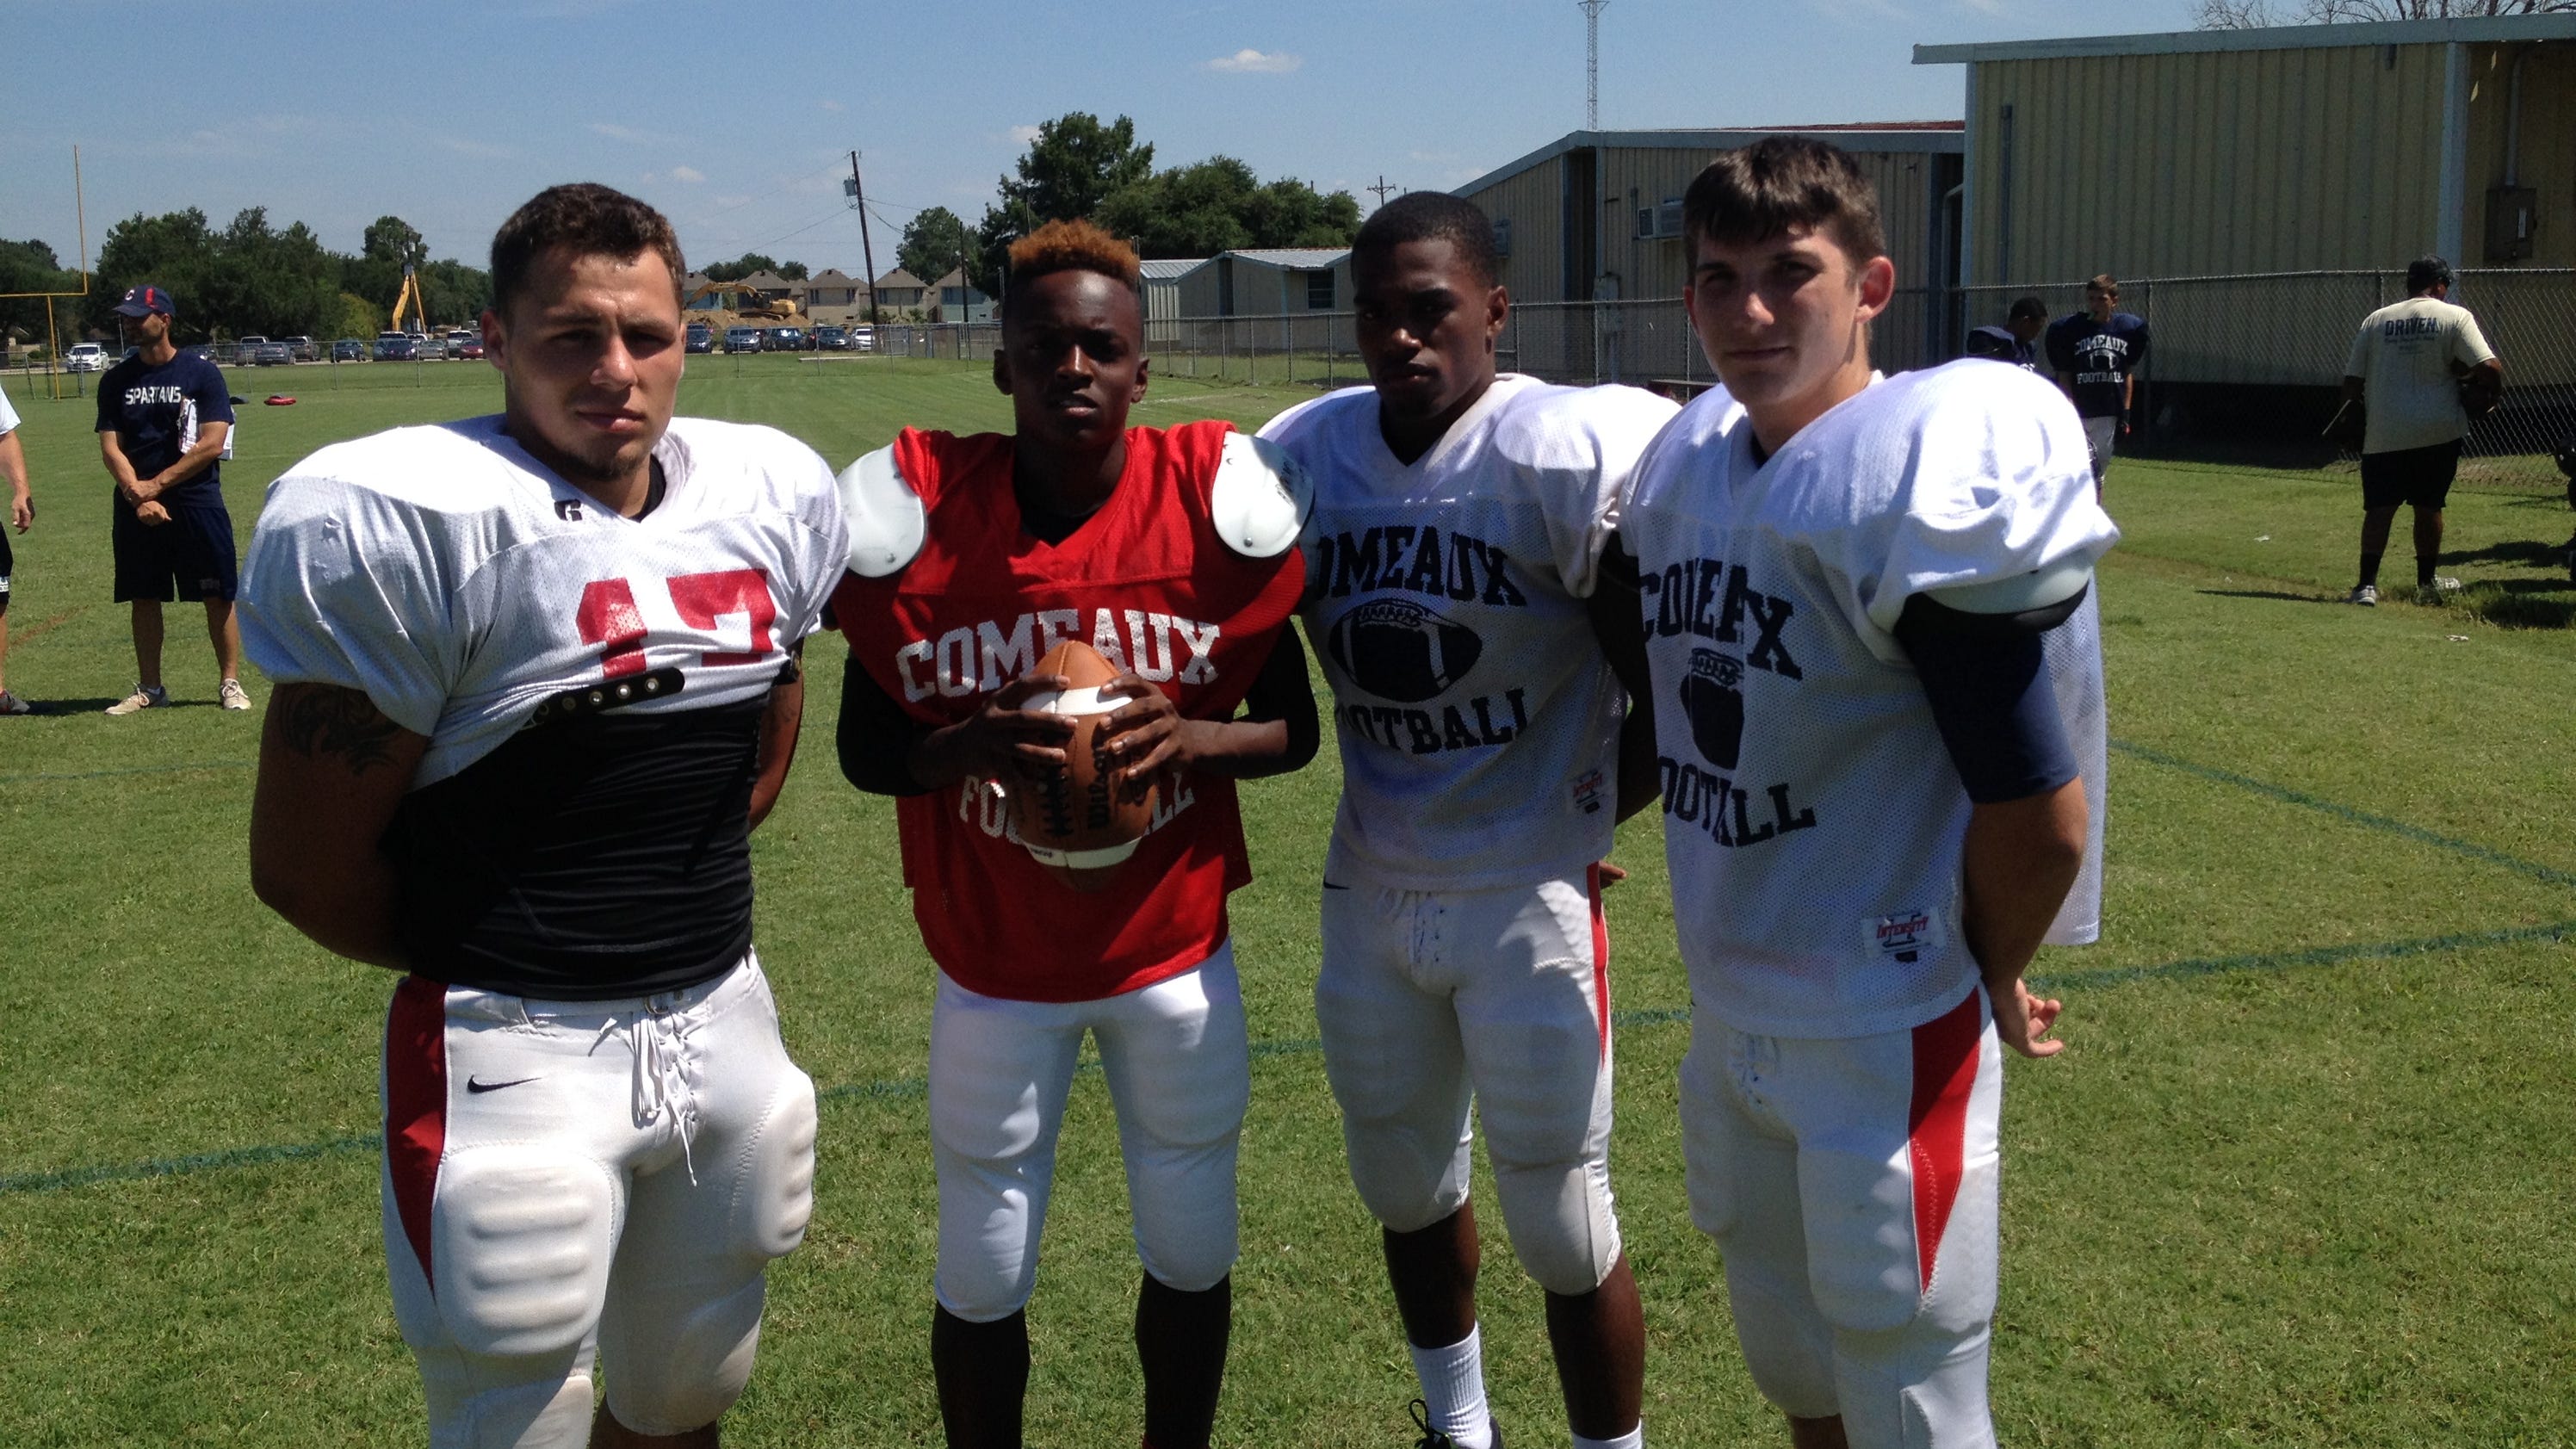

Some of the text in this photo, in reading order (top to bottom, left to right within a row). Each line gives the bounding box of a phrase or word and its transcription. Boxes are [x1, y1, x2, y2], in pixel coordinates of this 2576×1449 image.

[2075, 334, 2128, 356] COMEAUX
[125, 387, 182, 406] SPARTANS
[2077, 371, 2124, 384] FOOTBALL
[1316, 525, 1526, 606] OMEAUX
[1639, 558, 1803, 680] COEAX
[959, 773, 1196, 845] FOLL
